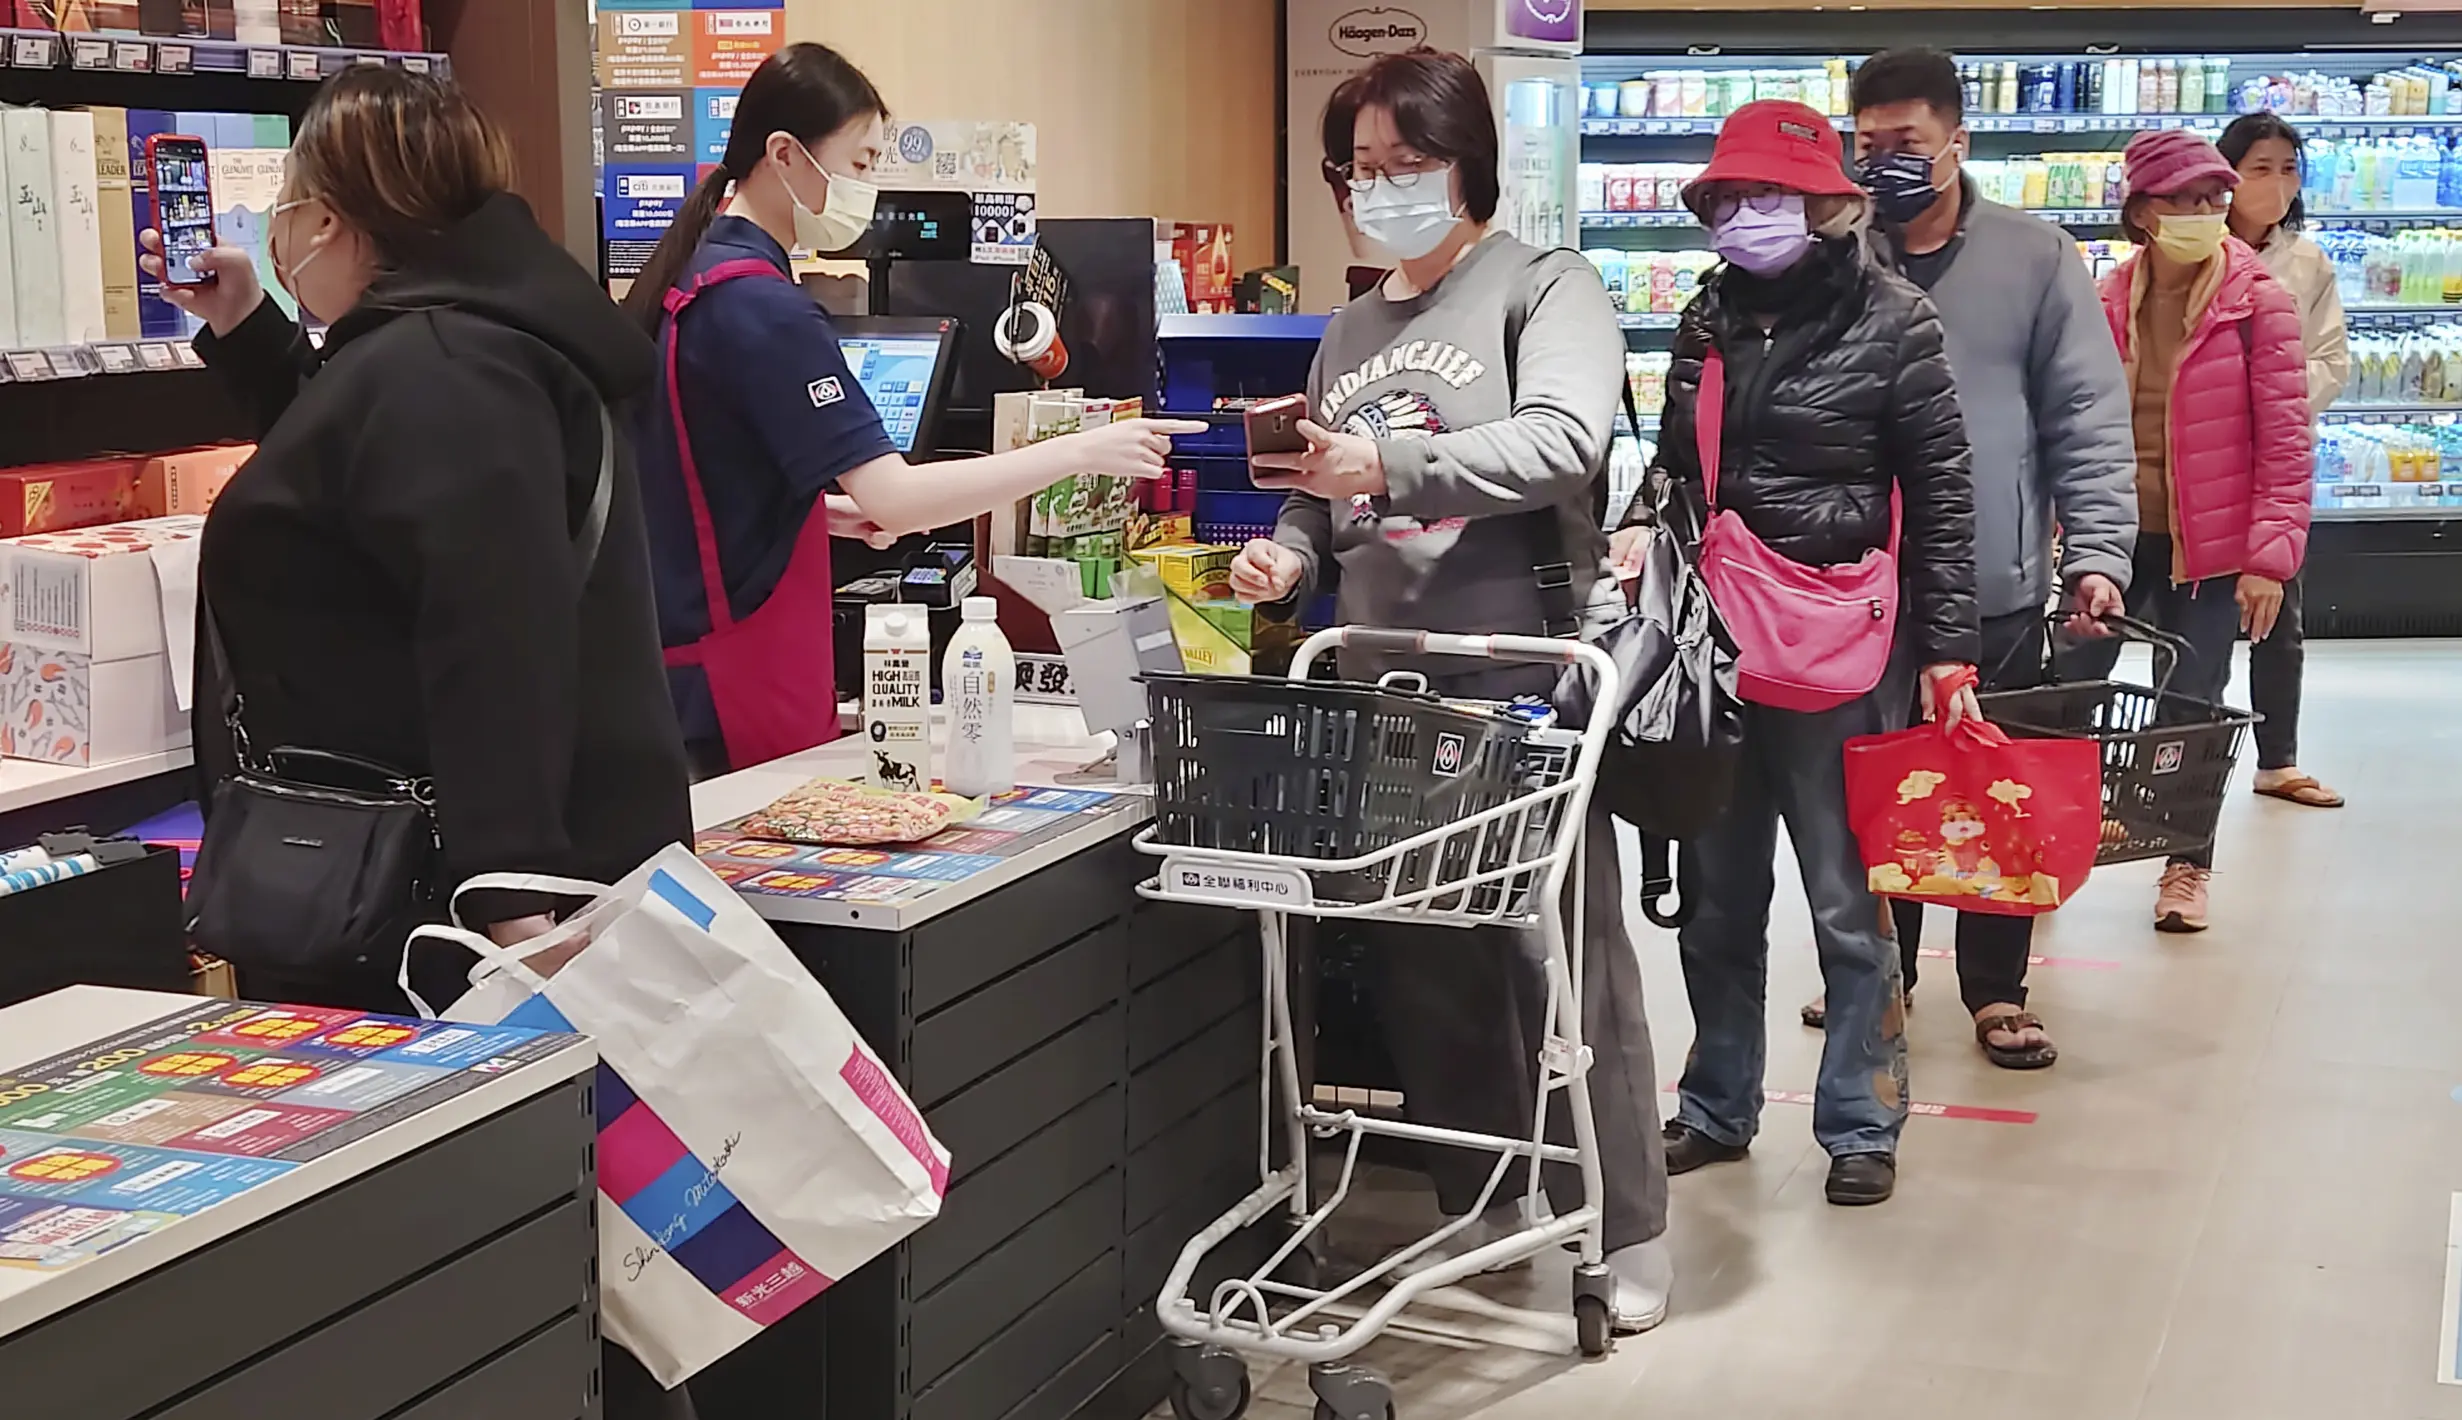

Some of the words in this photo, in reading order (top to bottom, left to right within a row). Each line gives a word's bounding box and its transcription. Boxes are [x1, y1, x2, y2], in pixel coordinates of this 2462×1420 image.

[1339, 25, 1417, 42] Häagen-Dazs
[903, 134, 923, 153] 99
[97, 163, 127, 176] LEADER
[938, 319, 951, 333] 2
[1184, 648, 1214, 665] VALLEY
[872, 670, 901, 682] HIGH
[872, 683, 920, 695] QUALITY
[891, 696, 920, 708] MILK
[961, 671, 983, 745] 自然零
[1203, 874, 1289, 896] 全聯福利中心
[76, 1048, 148, 1072] 200
[735, 1261, 804, 1308] 新光三越
